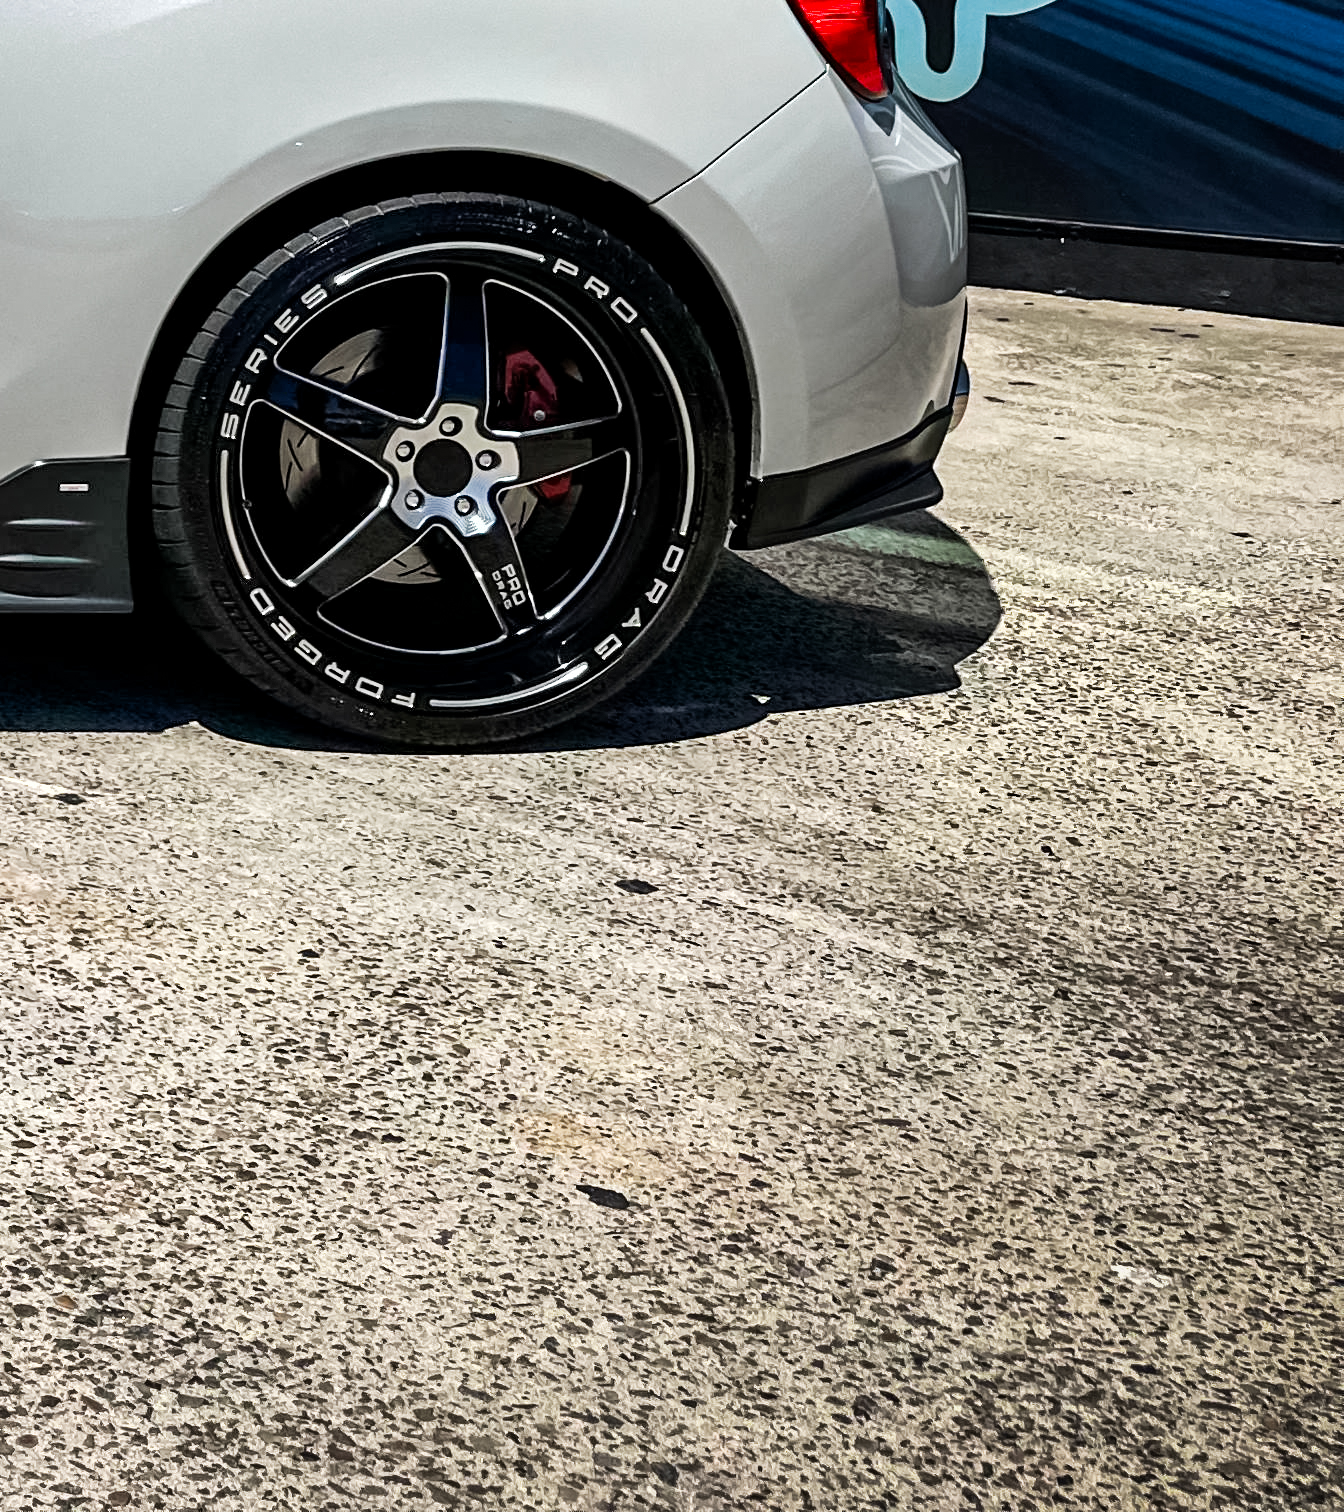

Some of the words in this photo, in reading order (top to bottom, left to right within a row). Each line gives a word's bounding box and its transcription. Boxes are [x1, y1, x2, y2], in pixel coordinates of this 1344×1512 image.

[551, 257, 639, 326] PRO
[220, 284, 330, 441] SERIES
[501, 563, 526, 606] PRO
[592, 544, 685, 661] DRAG
[248, 586, 418, 709] FORGED
